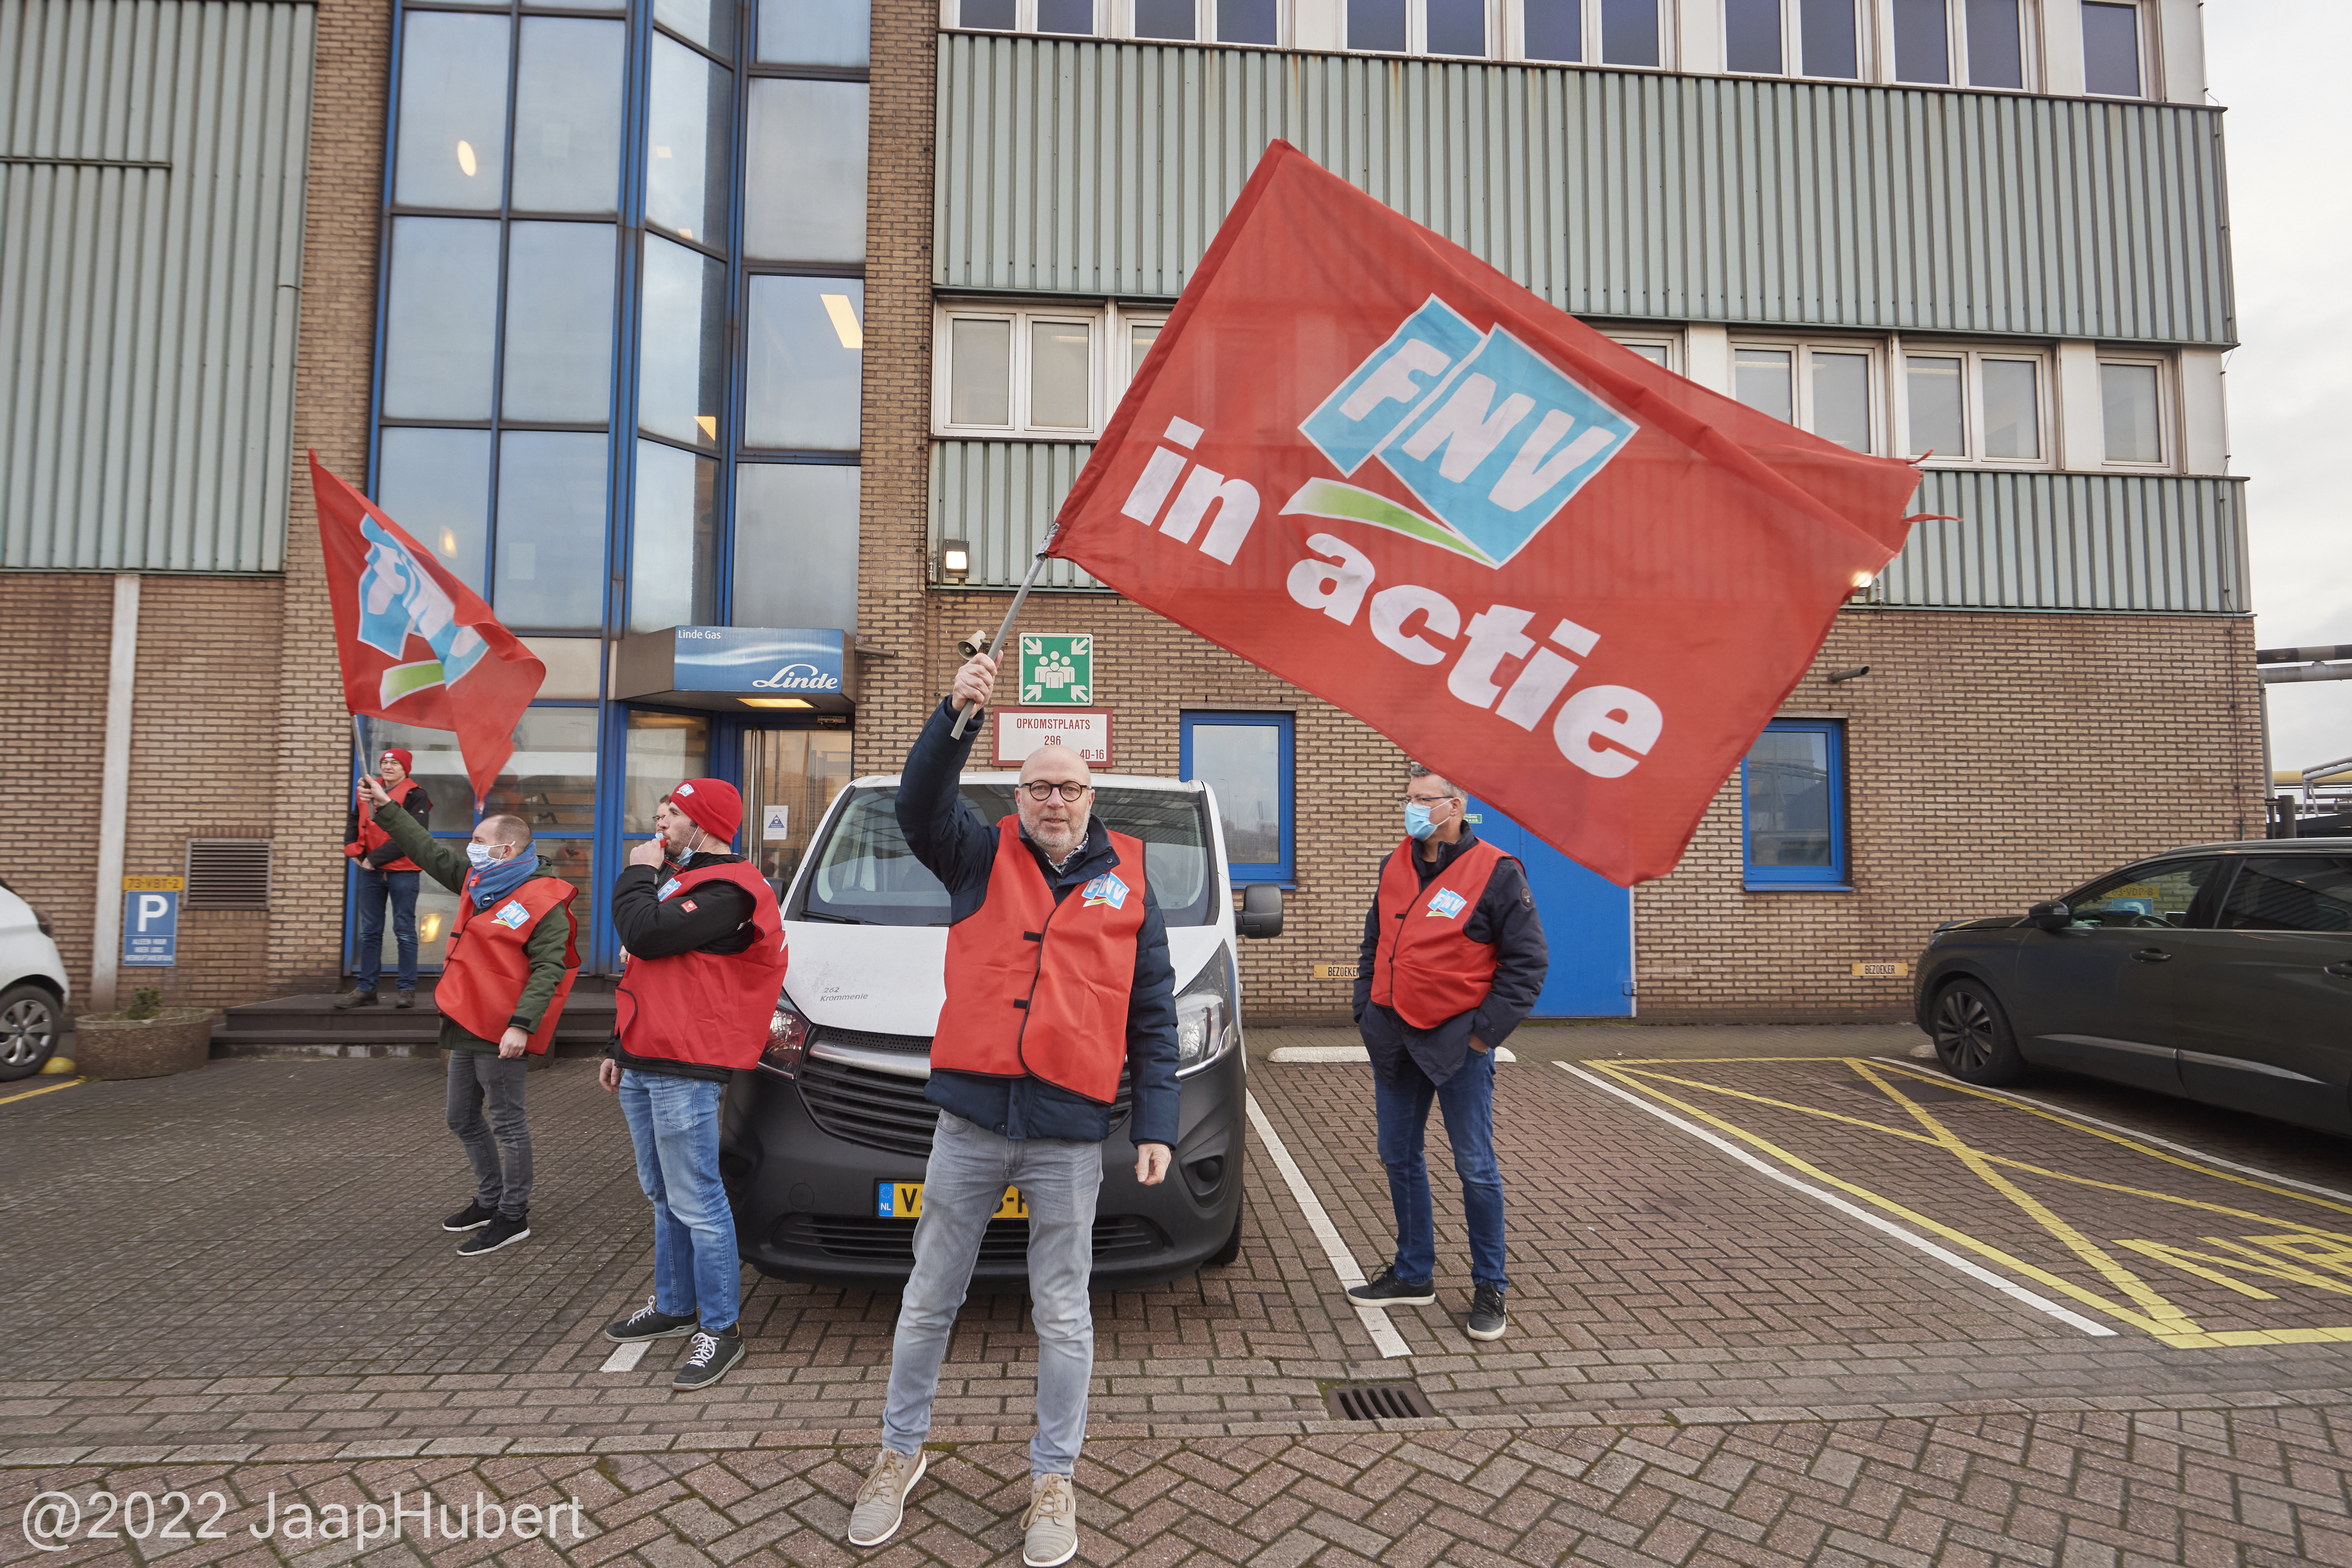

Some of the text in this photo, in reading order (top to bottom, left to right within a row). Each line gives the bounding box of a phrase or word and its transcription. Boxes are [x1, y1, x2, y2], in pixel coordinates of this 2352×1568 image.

[1338, 338, 1617, 512] FNV
[1120, 416, 1664, 779] in actie
[678, 630, 721, 640] Linde Gas
[752, 664, 838, 689] Linde
[1016, 718, 1090, 730] OPKOMSTPLAATS
[1044, 735, 1061, 746] 296
[1087, 877, 1127, 901] FNV
[1432, 893, 1464, 912] FNV
[137, 895, 169, 932] P
[500, 904, 528, 923] FNV
[1865, 965, 1895, 974] BEZOEKER
[819, 993, 868, 1002] Krommenie
[880, 1202, 892, 1211] NL
